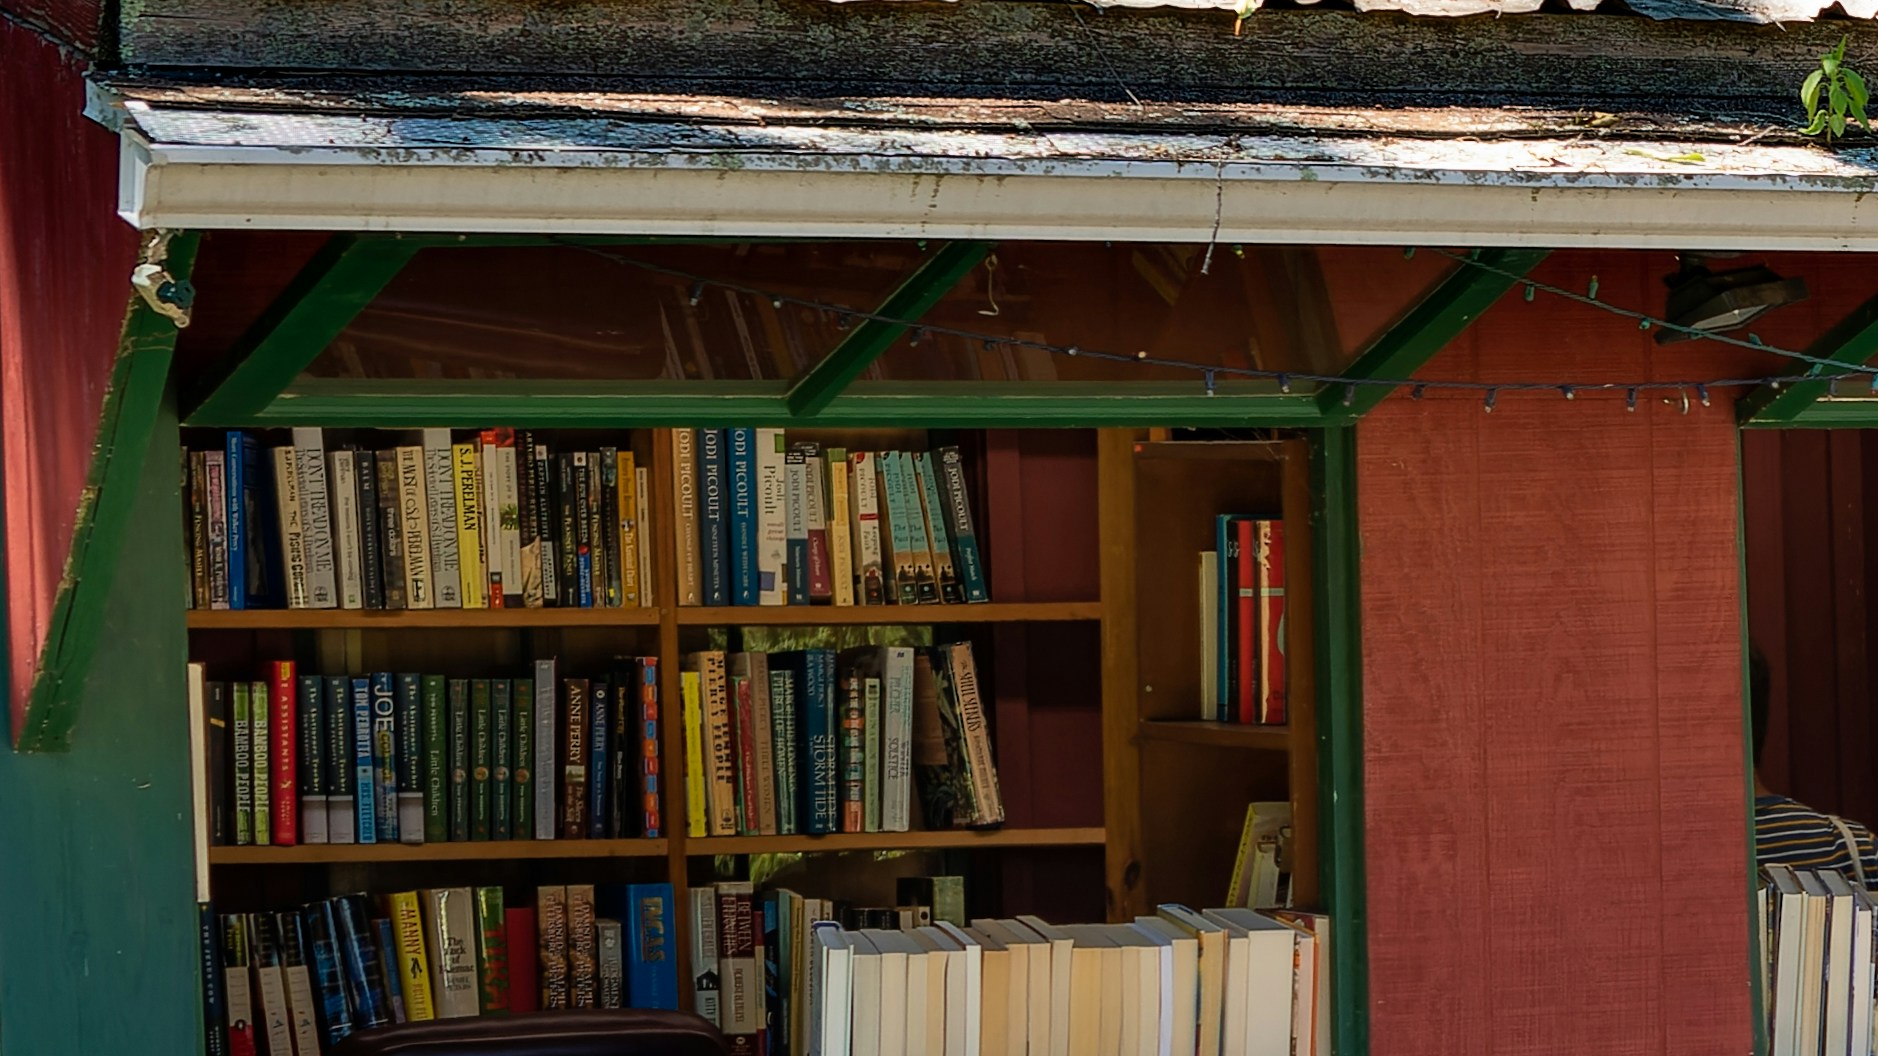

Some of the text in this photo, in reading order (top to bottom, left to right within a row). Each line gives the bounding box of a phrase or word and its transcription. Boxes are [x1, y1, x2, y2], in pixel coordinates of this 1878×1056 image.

[361, 462, 370, 490] BALM
[460, 448, 476, 530] S. J. PERELMAN
[680, 463, 693, 520] PICOULT
[704, 428, 720, 522] JODI PICOULT
[736, 461, 749, 518] PICOULT
[764, 465, 777, 515] Picoult
[775, 478, 784, 501] Jodi
[859, 468, 868, 509] PICOULT
[885, 463, 894, 504] PICOULT
[893, 472, 901, 494] JODI
[309, 491, 328, 530] TREAD
[440, 491, 455, 530] TREAD
[789, 469, 801, 533] JODI PICOULT
[806, 485, 817, 524] PICOULT
[947, 467, 969, 531] JODI PICOULT
[386, 508, 398, 556] three dollars
[407, 531, 424, 576] PERELMAN
[711, 524, 719, 558] NINETEEN
[871, 525, 879, 556] Keeping
[315, 552, 332, 572] ME
[444, 551, 459, 572] ME
[309, 687, 317, 703] The
[336, 687, 345, 703] The
[373, 684, 394, 732] JOE
[408, 685, 417, 700] The
[707, 657, 719, 718] PIERCY
[281, 695, 289, 771] ASSISTANTS
[356, 687, 371, 758] TOM PERROTTA
[455, 711, 463, 766] Little Children
[477, 709, 485, 730] Little
[498, 709, 506, 764] Little Children
[519, 711, 528, 766] Little Children
[570, 685, 582, 763] ANNE PERRY
[594, 702, 605, 752] ANNE PERRY
[235, 720, 250, 813] BAMBOO PEOPLE
[254, 720, 269, 812] BAMBOO PEOPLE
[311, 759, 319, 792] Teacher
[338, 759, 346, 792] Teacher
[410, 756, 418, 788] Teacher
[813, 735, 828, 819] STORM TIDE
[888, 737, 899, 780] SOLSTICE
[430, 750, 440, 816] Little Children
[400, 909, 421, 955] MANNY
[737, 901, 751, 951] BETWEEN
